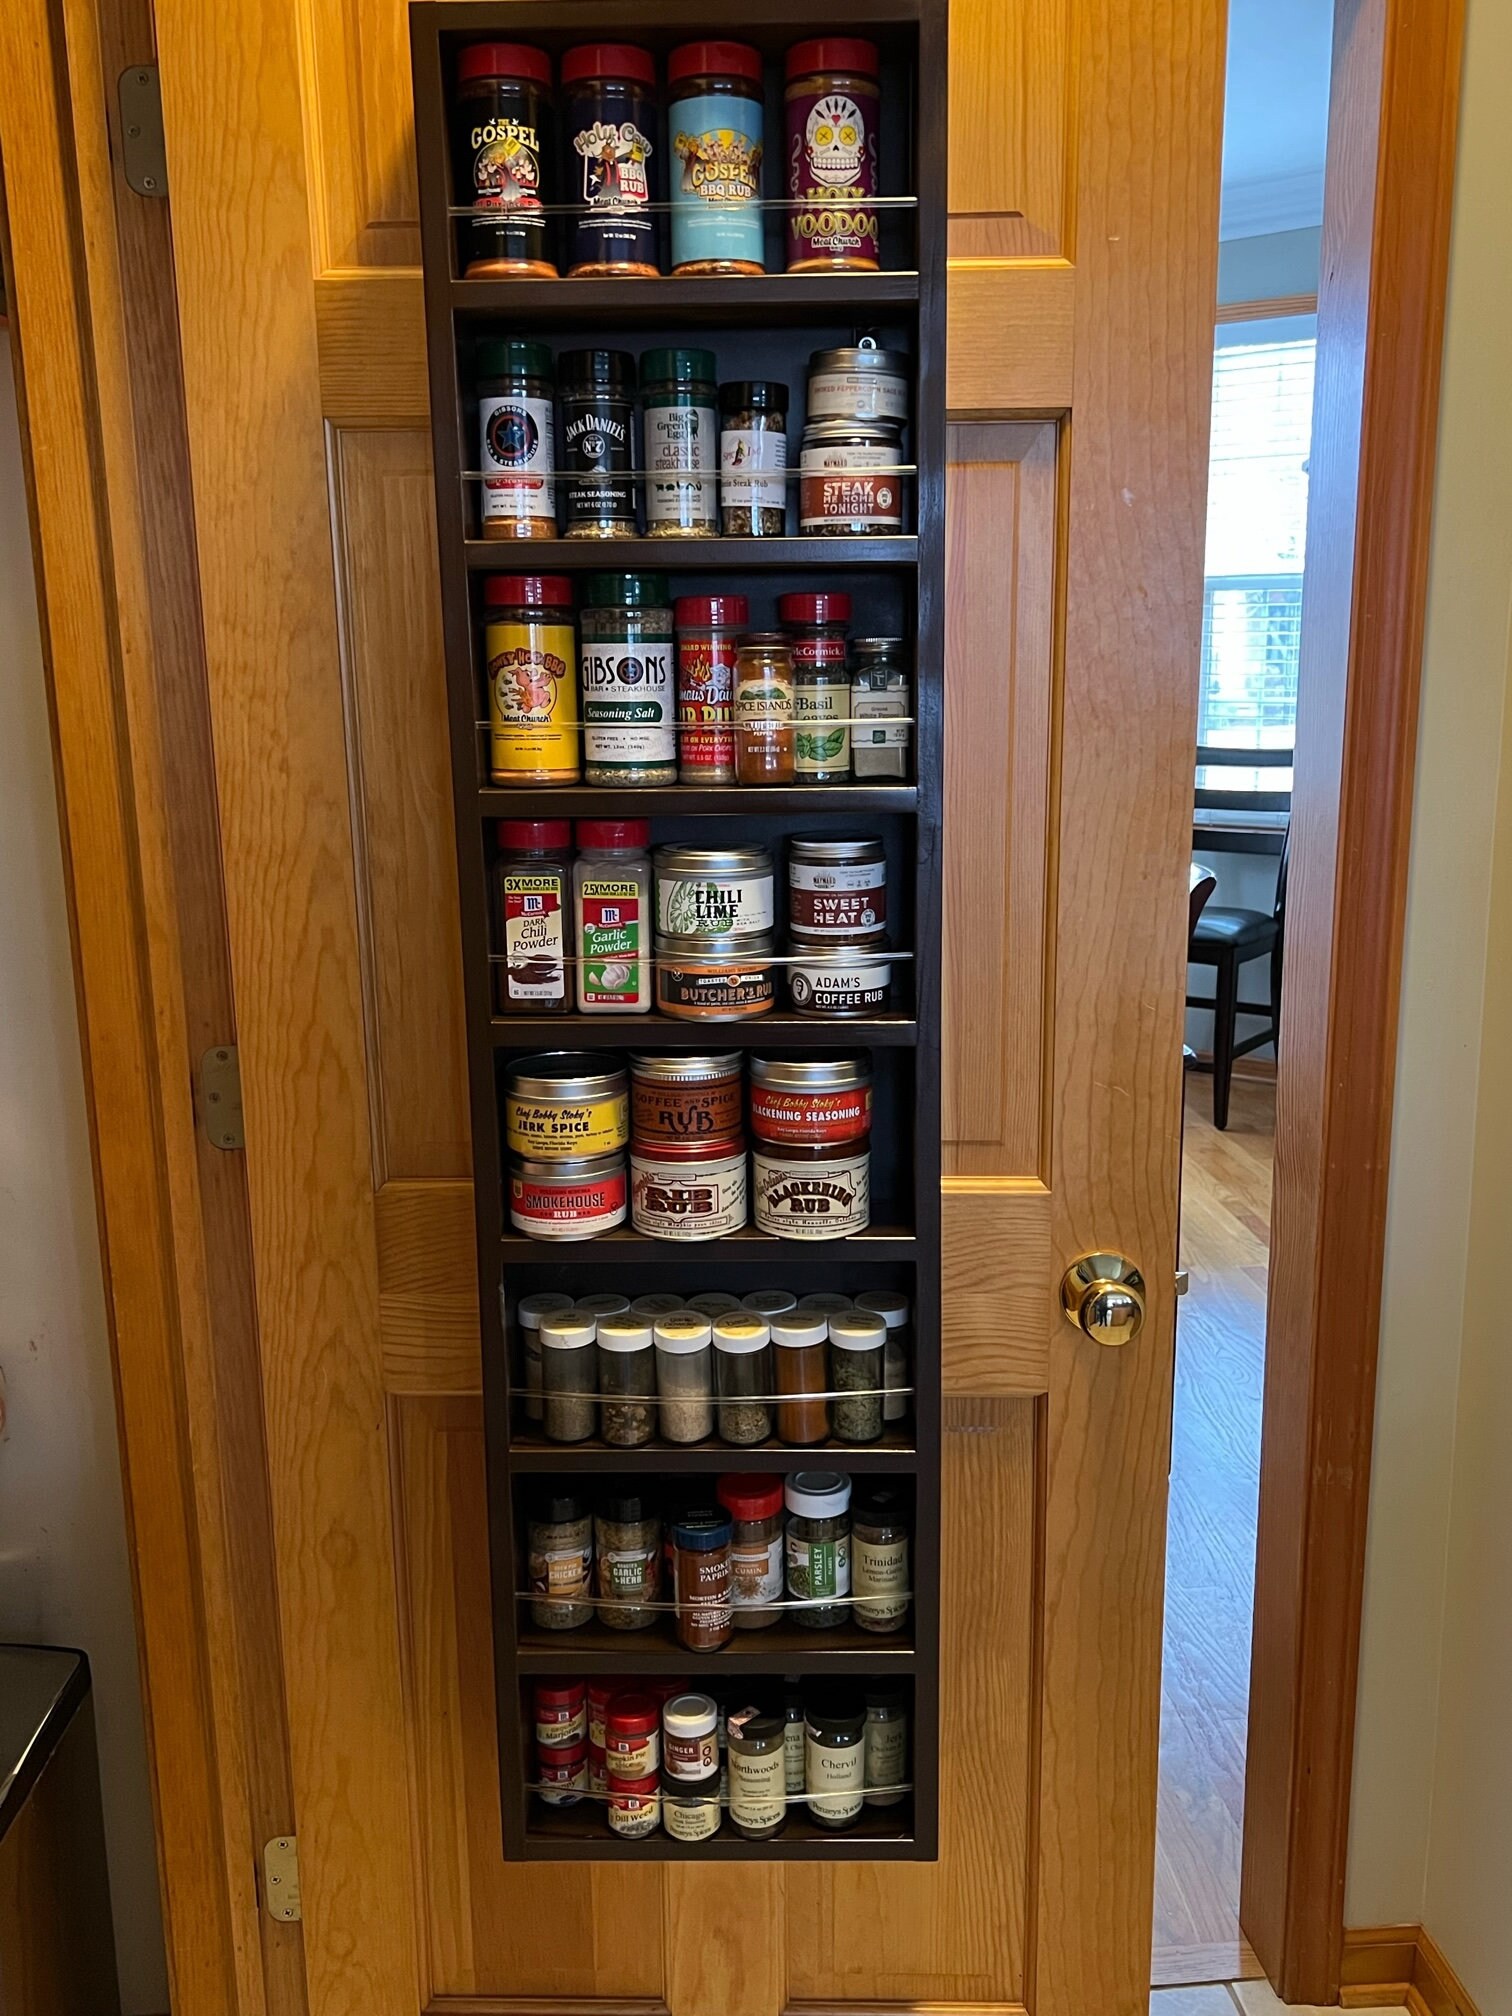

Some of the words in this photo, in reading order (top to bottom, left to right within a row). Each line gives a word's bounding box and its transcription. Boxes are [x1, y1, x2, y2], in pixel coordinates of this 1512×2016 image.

[471, 125, 540, 153] GOSPEL
[575, 122, 618, 151] Holy
[620, 167, 645, 181] BBQ
[620, 180, 645, 193] RUB
[700, 184, 725, 197] BBQ
[728, 184, 751, 198] RUB
[791, 210, 879, 240] VOODOO
[813, 238, 831, 246] Meat
[494, 405, 527, 417] GIBSONS
[668, 412, 684, 423] Big
[566, 418, 586, 443] JACK
[585, 413, 626, 443] DANIEL'S
[656, 422, 684, 431] Green
[667, 429, 687, 440] Egg
[499, 439, 539, 467] STEAKHOUSE
[733, 479, 752, 487] Steak
[754, 479, 769, 488] Rub
[823, 481, 874, 496] STEAK
[587, 490, 627, 498] SEASONING
[842, 494, 875, 503] HOME
[823, 503, 874, 514] TONIGHT
[545, 655, 565, 675] BBQ
[582, 656, 666, 691] GIBSONS
[735, 701, 755, 711] SPICE
[757, 699, 792, 711] ISLANDS
[797, 696, 833, 710] Basil
[503, 714, 520, 722] Meat
[521, 714, 549, 723] Church
[587, 707, 633, 721] Seasoning
[634, 707, 655, 718] Salt
[506, 878, 522, 891] 3X
[521, 878, 559, 887] MORE
[600, 884, 636, 892] MORE
[695, 889, 743, 904] CHILI
[813, 896, 870, 911] SWEET
[695, 904, 739, 918] LIME
[813, 911, 858, 924] HEAT
[523, 918, 546, 928] DARK
[695, 918, 734, 927] RUB
[521, 925, 547, 939] Chili
[592, 928, 627, 943] Garlic
[513, 936, 559, 952] Powder
[590, 940, 632, 955] Powder
[815, 976, 861, 988] ADAM'S
[815, 993, 862, 1005] COFFEE
[864, 989, 884, 1003] RUB
[635, 1092, 682, 1108] COFFEE
[701, 1092, 735, 1108] SPICE
[783, 1097, 809, 1111] Bobby
[810, 1097, 842, 1109] Stoky's
[532, 1109, 558, 1122] Bobby
[559, 1108, 593, 1121] Stoky's
[658, 1105, 715, 1135] RUB
[805, 1106, 861, 1122] SEASONING
[518, 1120, 546, 1133] JERK
[551, 1121, 590, 1133] SPICE
[525, 1191, 606, 1209] SMOKEHOUSE
[767, 1180, 854, 1209] BLACKENING
[790, 1197, 831, 1213] RUB
[552, 1210, 578, 1218] RUB
[863, 1552, 903, 1567] Trinidad
[612, 1567, 642, 1577] GARLIC
[734, 1567, 763, 1575] CUMIN
[813, 1548, 823, 1586] PARSLEY
[619, 1575, 642, 1585] HERB
[668, 1743, 695, 1754] GINGER
[730, 1757, 780, 1774] Northwoods
[821, 1756, 857, 1770] Chervil
[630, 1805, 655, 1822] Weed
[673, 1810, 706, 1821] Chicago
